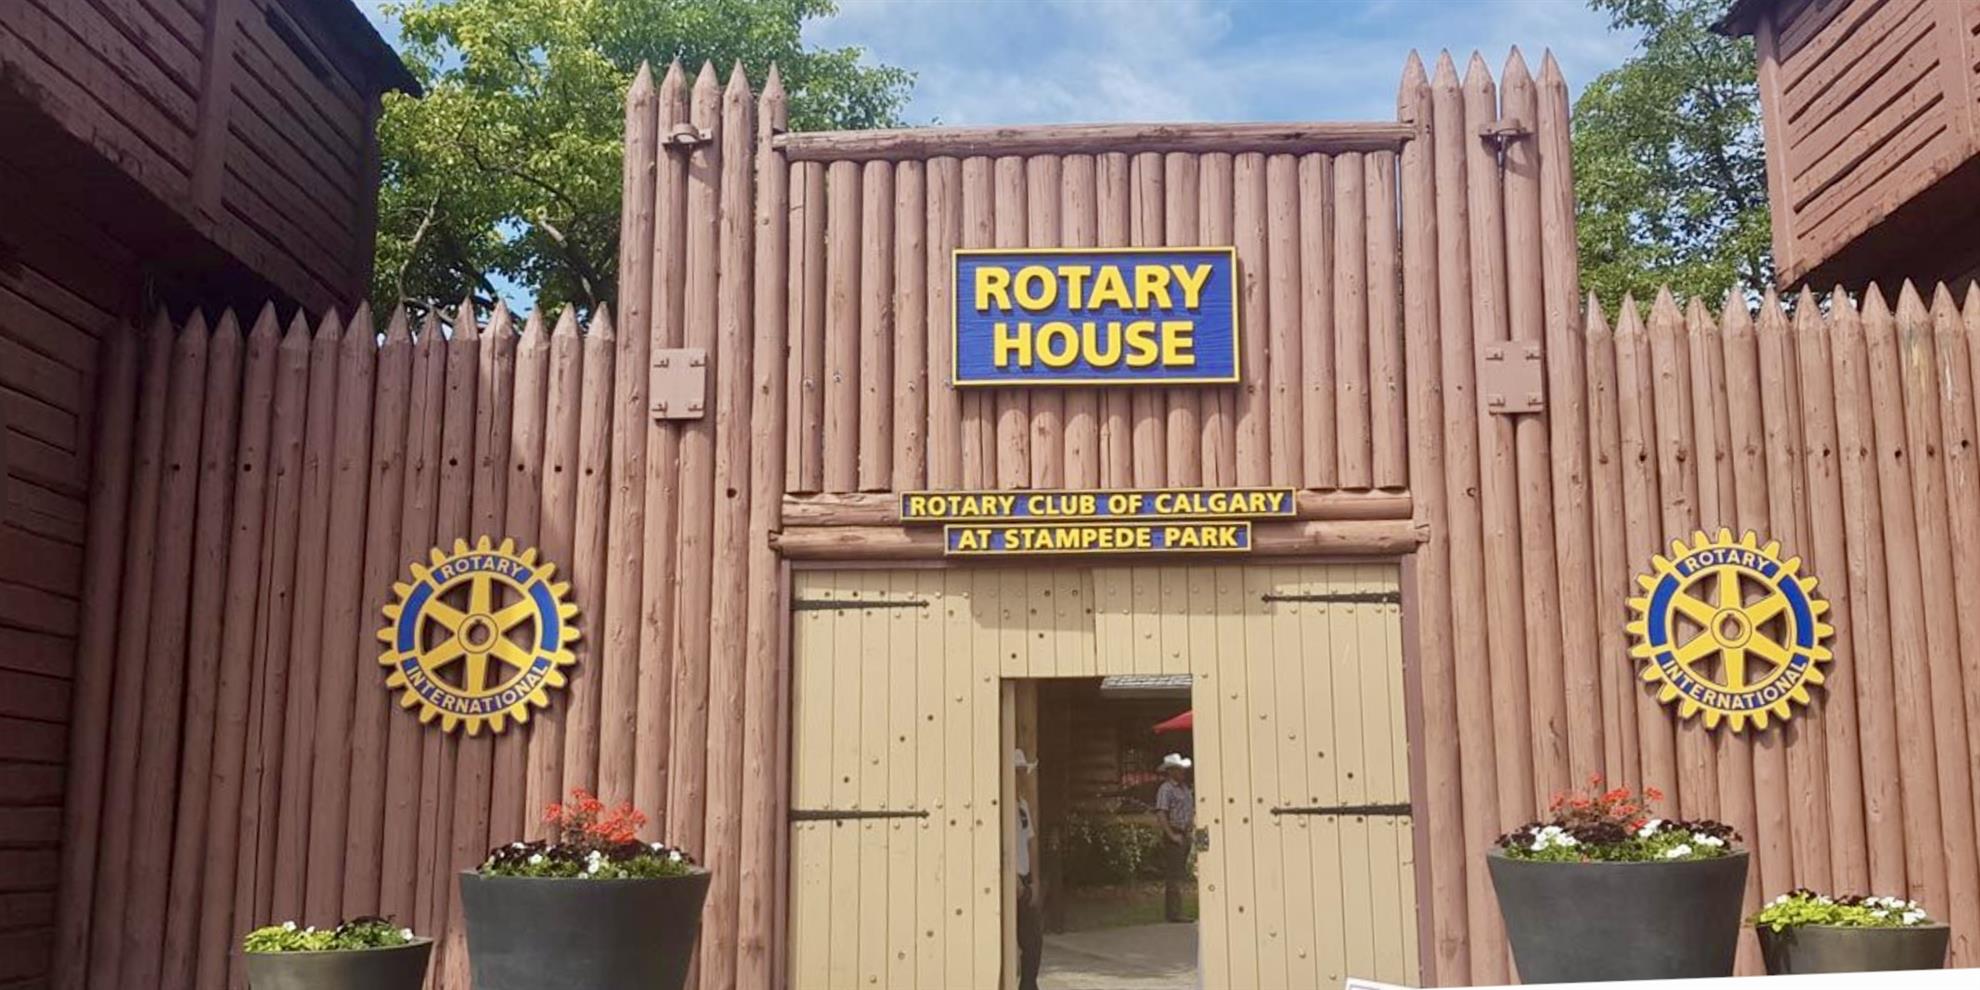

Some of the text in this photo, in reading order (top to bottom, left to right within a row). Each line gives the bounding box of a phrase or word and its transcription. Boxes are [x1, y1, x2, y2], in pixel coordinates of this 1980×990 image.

[974, 264, 1213, 311] ROTARY
[993, 320, 1196, 367] HOUSE
[910, 492, 1285, 516] ROTARY CLUB OF CALGARY
[958, 526, 1238, 549] AT STAMPEDE PARK
[441, 556, 526, 579] ROTARY
[1685, 549, 1771, 573] ROTARY
[407, 665, 549, 714] INTERNATIONAL
[1662, 660, 1808, 709] INTERNATIONAL
